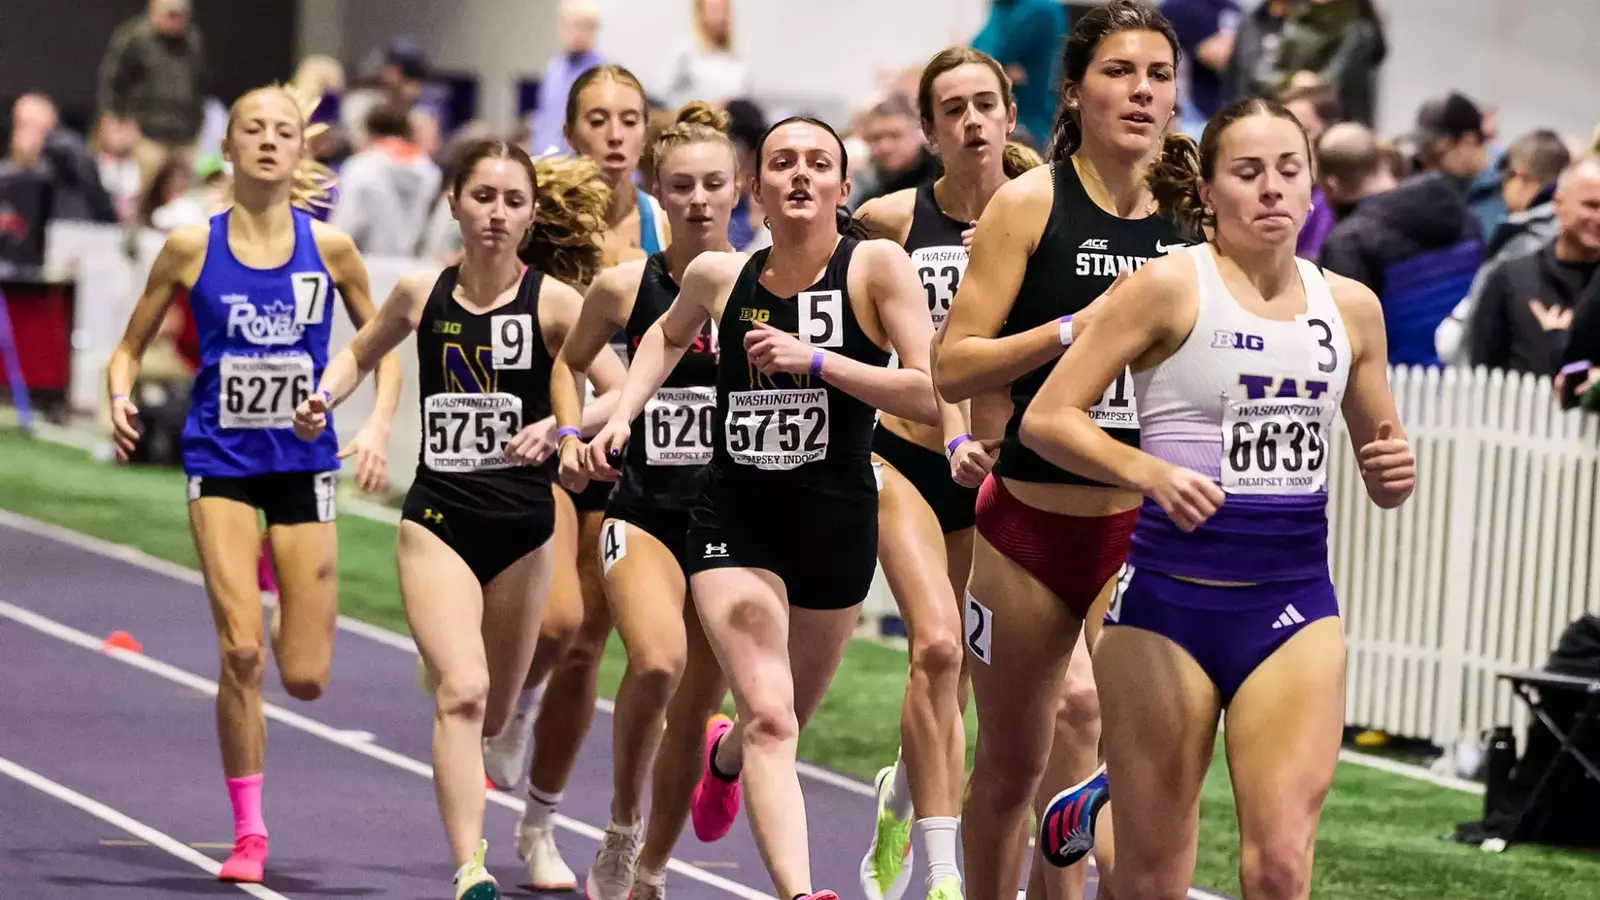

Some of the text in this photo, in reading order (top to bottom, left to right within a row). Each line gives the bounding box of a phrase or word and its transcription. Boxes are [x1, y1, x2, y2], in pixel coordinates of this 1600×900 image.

[1080, 238, 1109, 249] ACC
[301, 277, 319, 319] 7
[809, 294, 833, 344] 5
[500, 318, 524, 366] 9
[1307, 318, 1338, 373] 3
[226, 374, 308, 414] 6276
[432, 397, 514, 409] WASHINGTON
[734, 392, 821, 407] WASHINGTON
[428, 411, 519, 454] 5753
[729, 406, 827, 452] 5752
[1087, 410, 1134, 421] DEMPSEY
[659, 452, 700, 460] DEMPSEY
[1229, 421, 1325, 472] 6639
[1238, 477, 1283, 487] DEMPSEY
[605, 524, 620, 562] 4
[969, 600, 984, 658] 2
